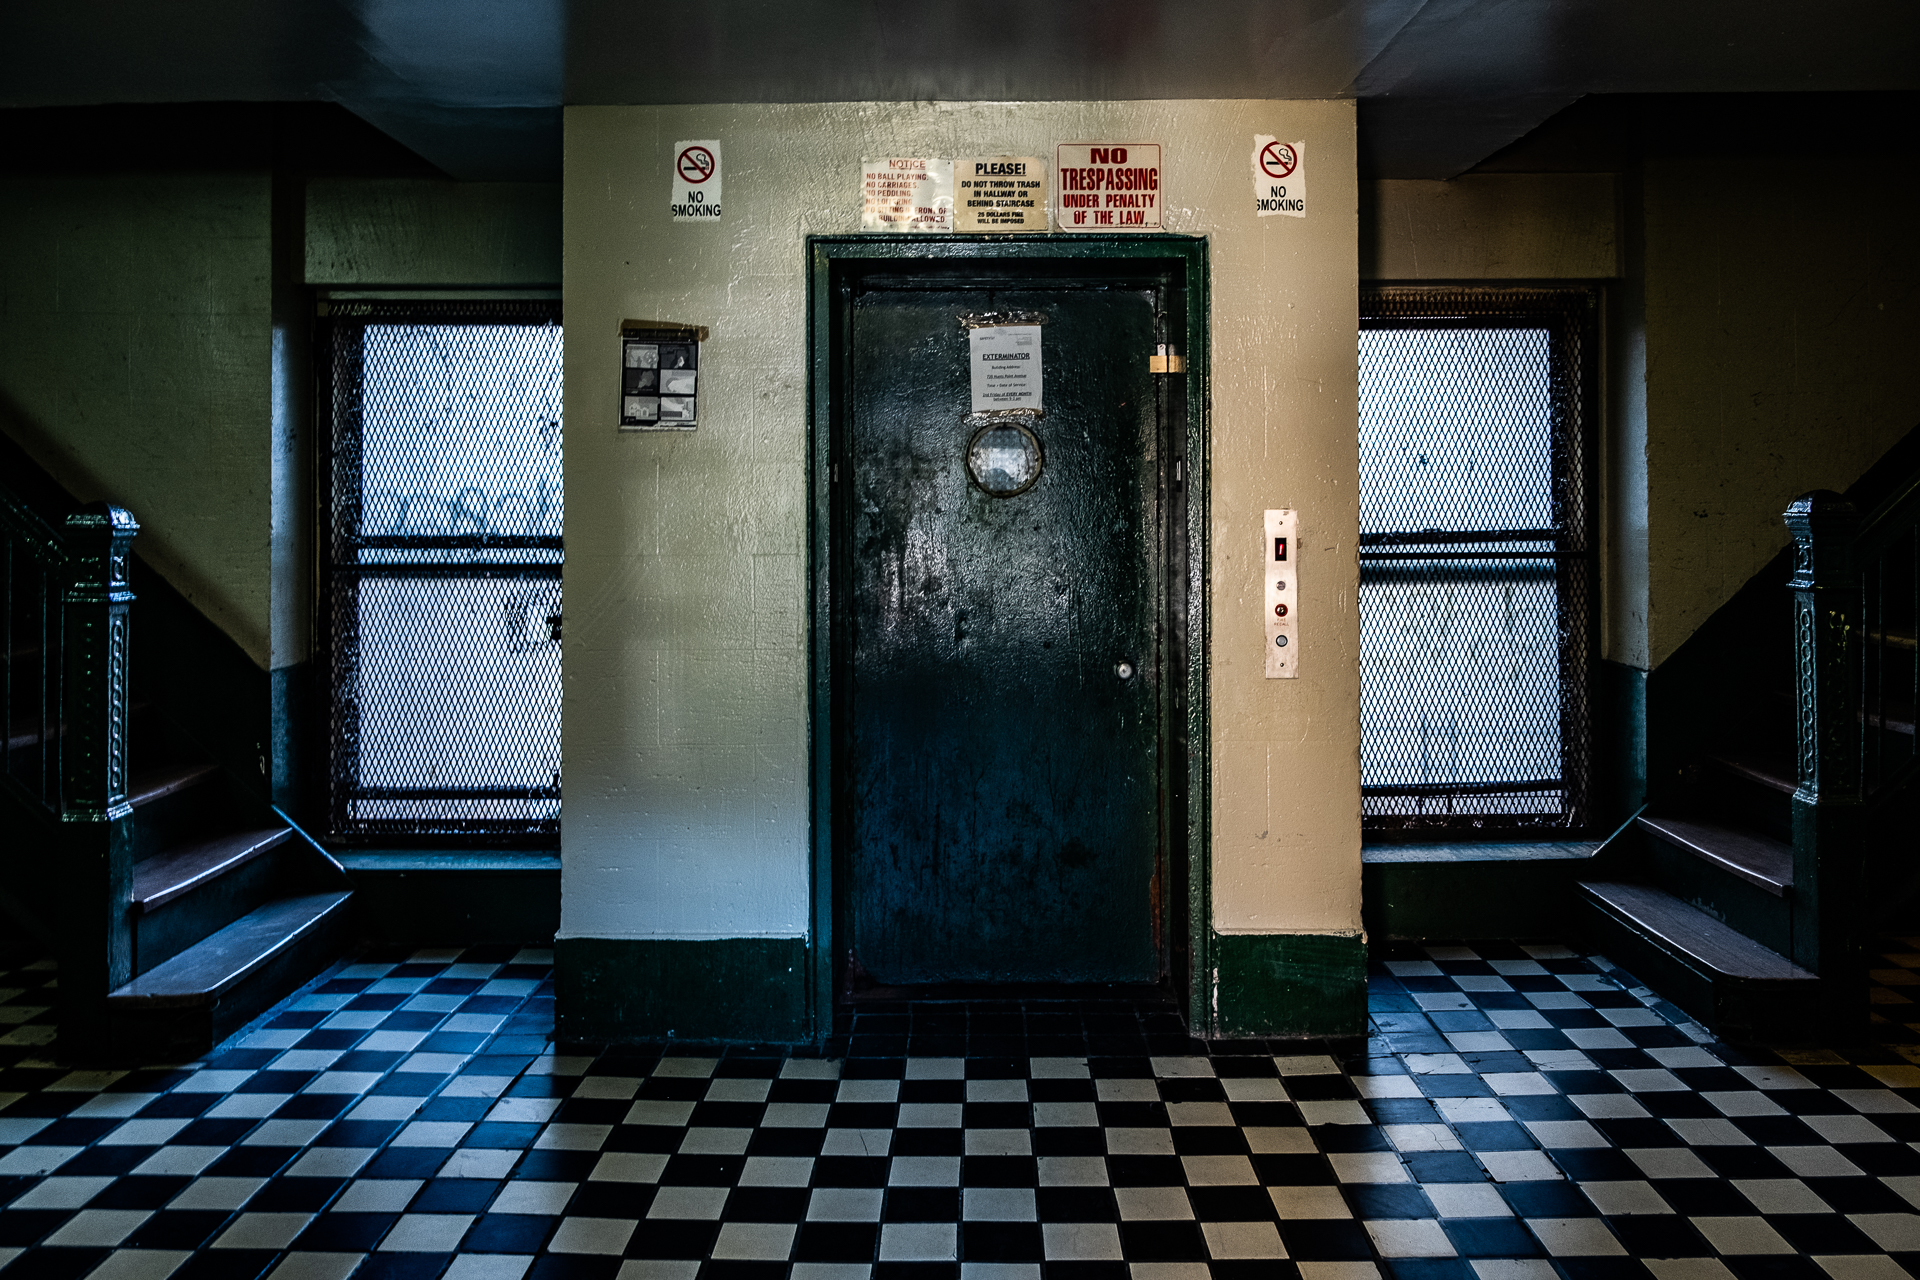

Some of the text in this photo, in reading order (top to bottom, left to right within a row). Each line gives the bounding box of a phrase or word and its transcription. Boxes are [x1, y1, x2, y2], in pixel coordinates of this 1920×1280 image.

[1090, 148, 1128, 164] NO
[889, 160, 926, 169] NOTICE
[975, 163, 1026, 175] PLEASE!
[1061, 168, 1158, 191] TRESPASSING
[688, 191, 704, 203] NO
[1271, 186, 1287, 198] NO
[1063, 194, 1155, 208] UNDER PENALTY
[671, 204, 721, 217] SMOKING
[1073, 210, 1145, 225] OF THE LAW
[1279, 544, 1284, 555] 1
